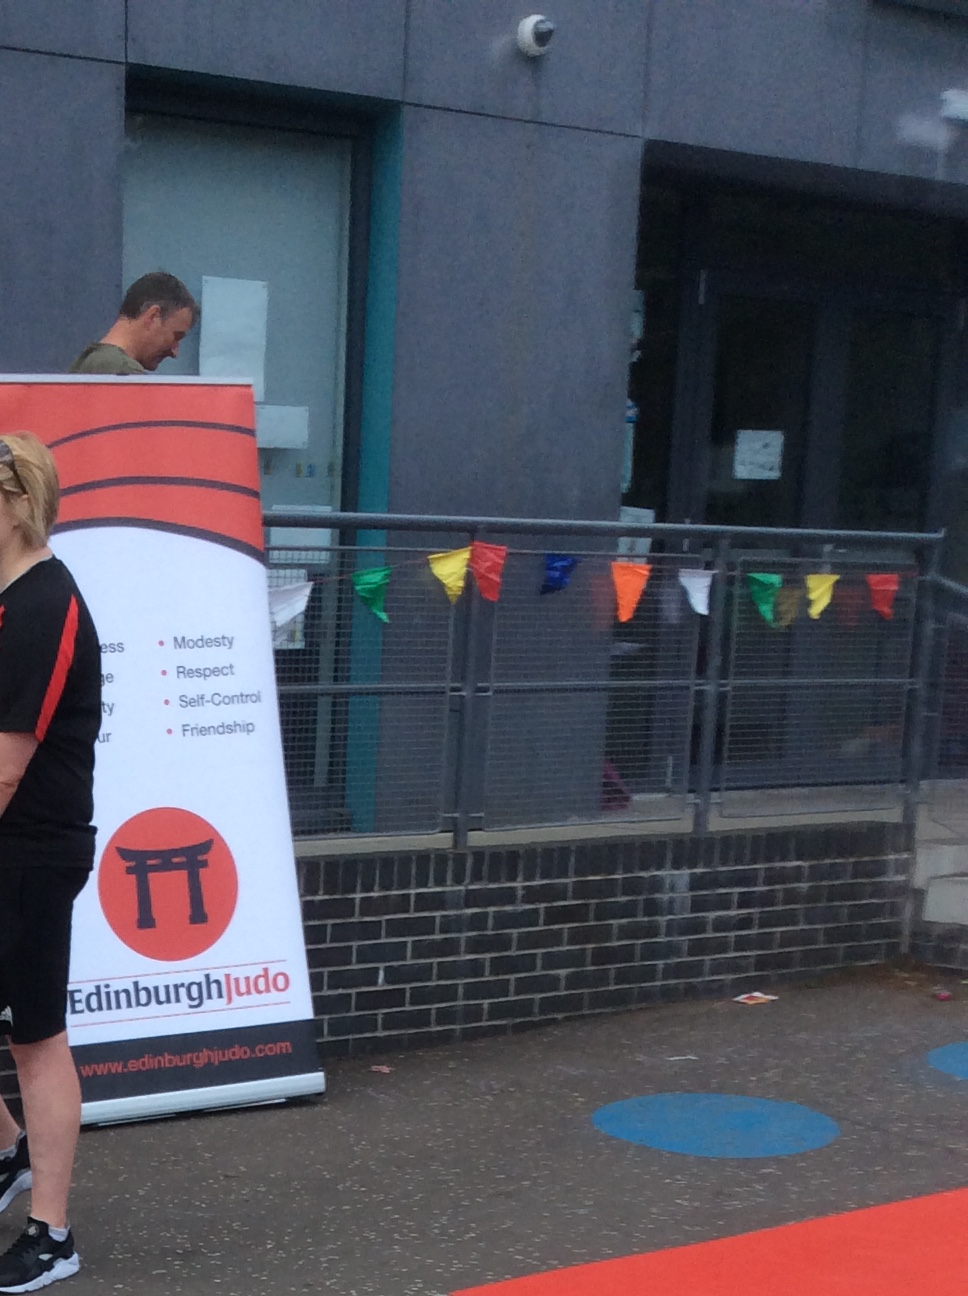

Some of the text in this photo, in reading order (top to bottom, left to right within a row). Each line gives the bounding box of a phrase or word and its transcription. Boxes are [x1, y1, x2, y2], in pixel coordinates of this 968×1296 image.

[173, 634, 234, 650] Modesty
[176, 663, 235, 681] Respect
[178, 690, 262, 709] Self-Control
[181, 720, 255, 738] Friendship
[79, 1040, 292, 1077] www.edinburghjudo.com
